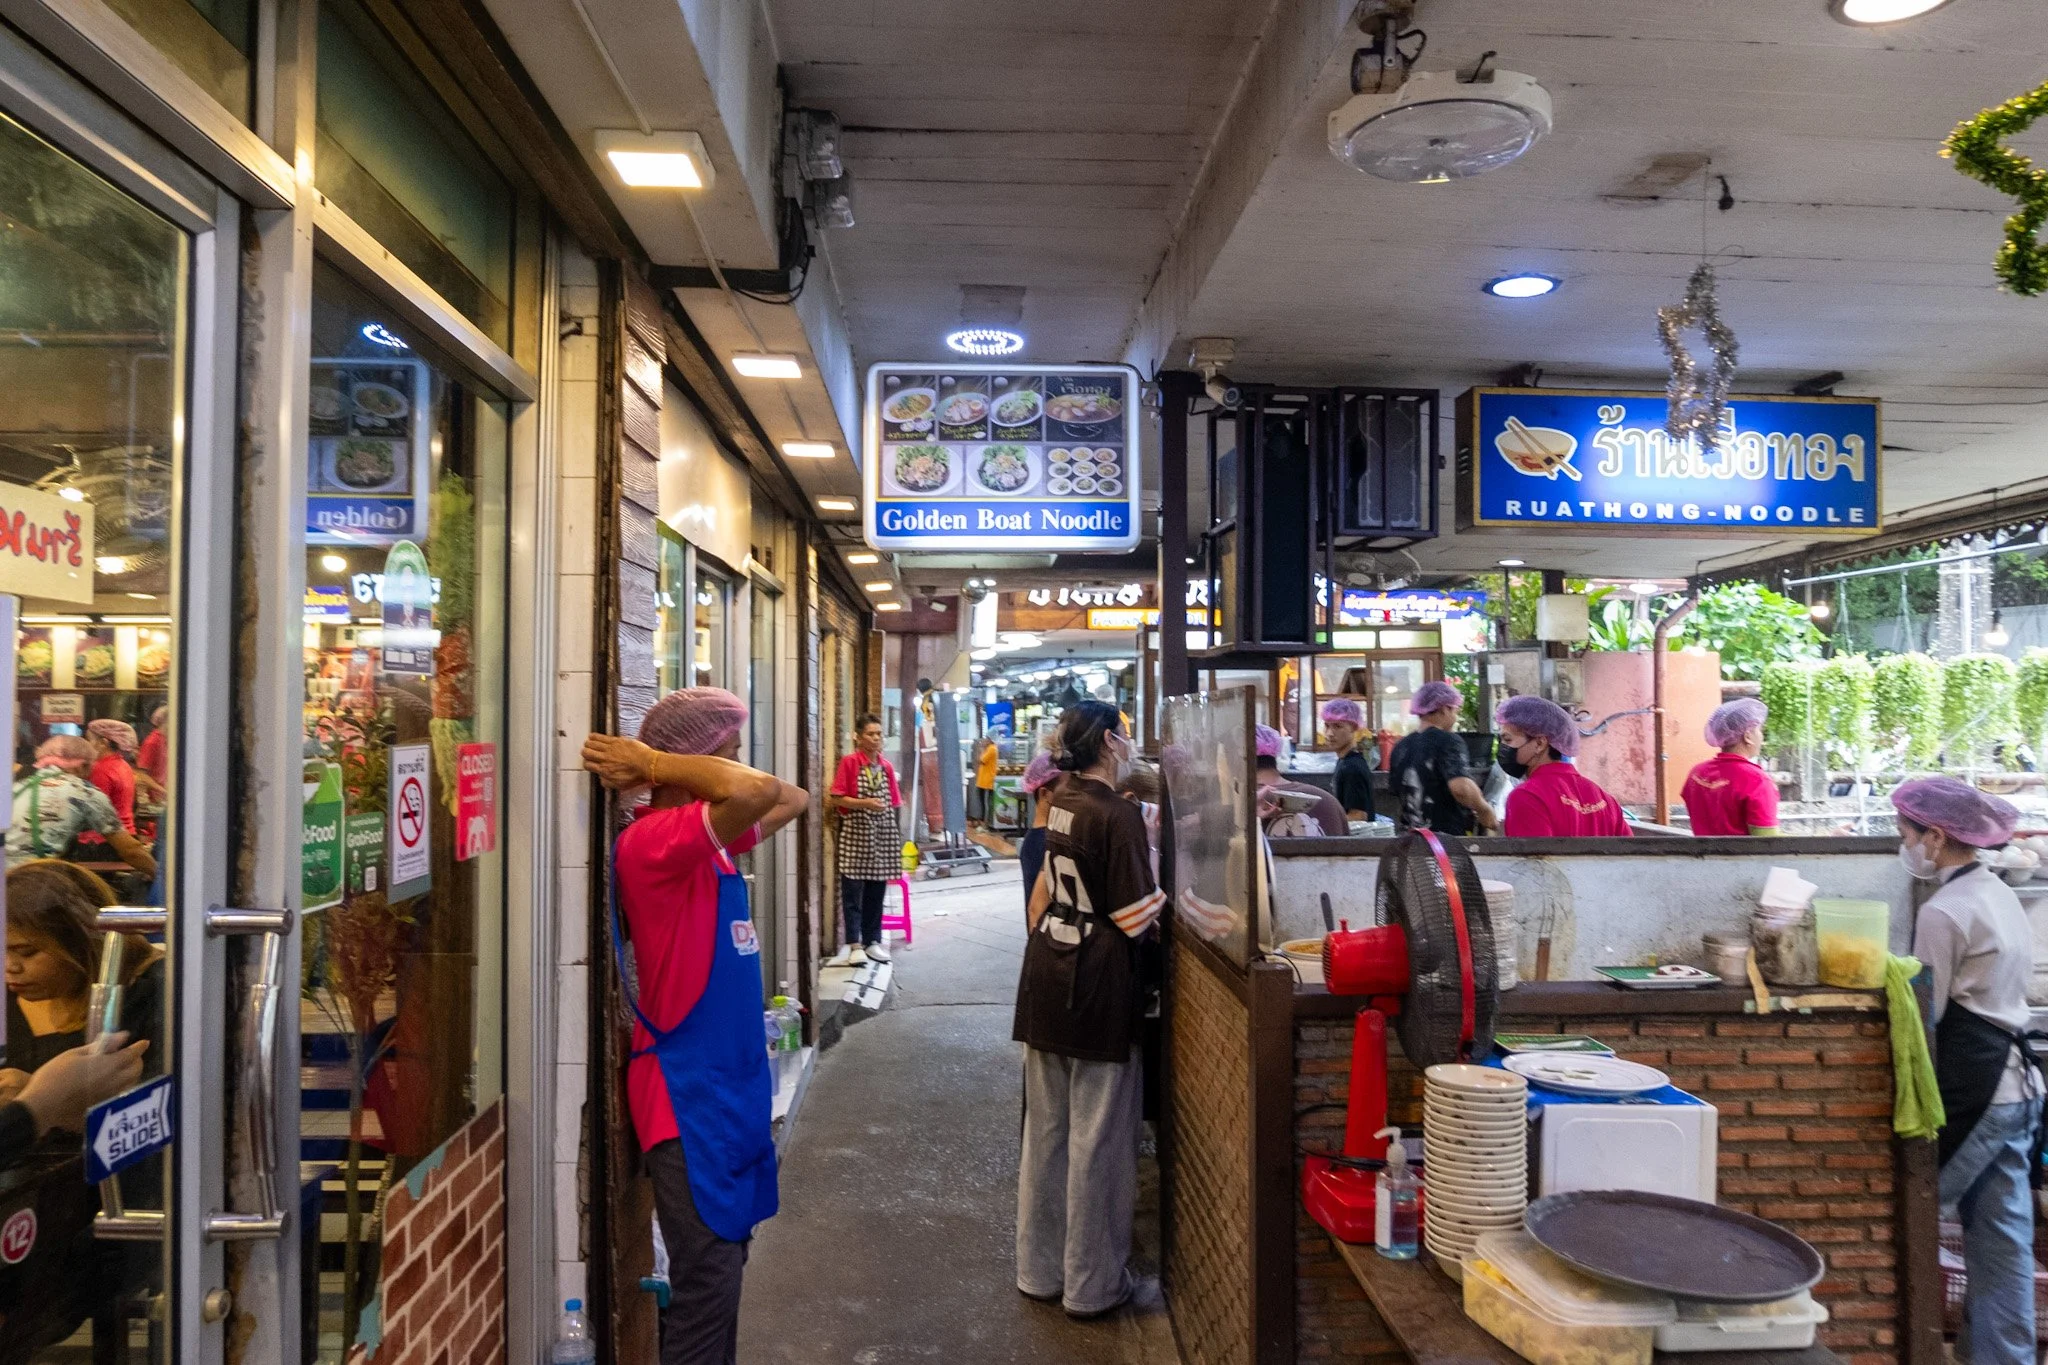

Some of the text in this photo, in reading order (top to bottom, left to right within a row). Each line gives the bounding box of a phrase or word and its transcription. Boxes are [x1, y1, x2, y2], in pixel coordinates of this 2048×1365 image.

[882, 508, 1123, 531] Golden Boat Noodle
[1506, 499, 1866, 524] RUATHONG-NOODLE
[461, 753, 494, 776] CLOSED
[347, 827, 384, 849] GrabFood
[109, 1121, 160, 1160] SLIDE
[7, 1220, 29, 1252] 12
